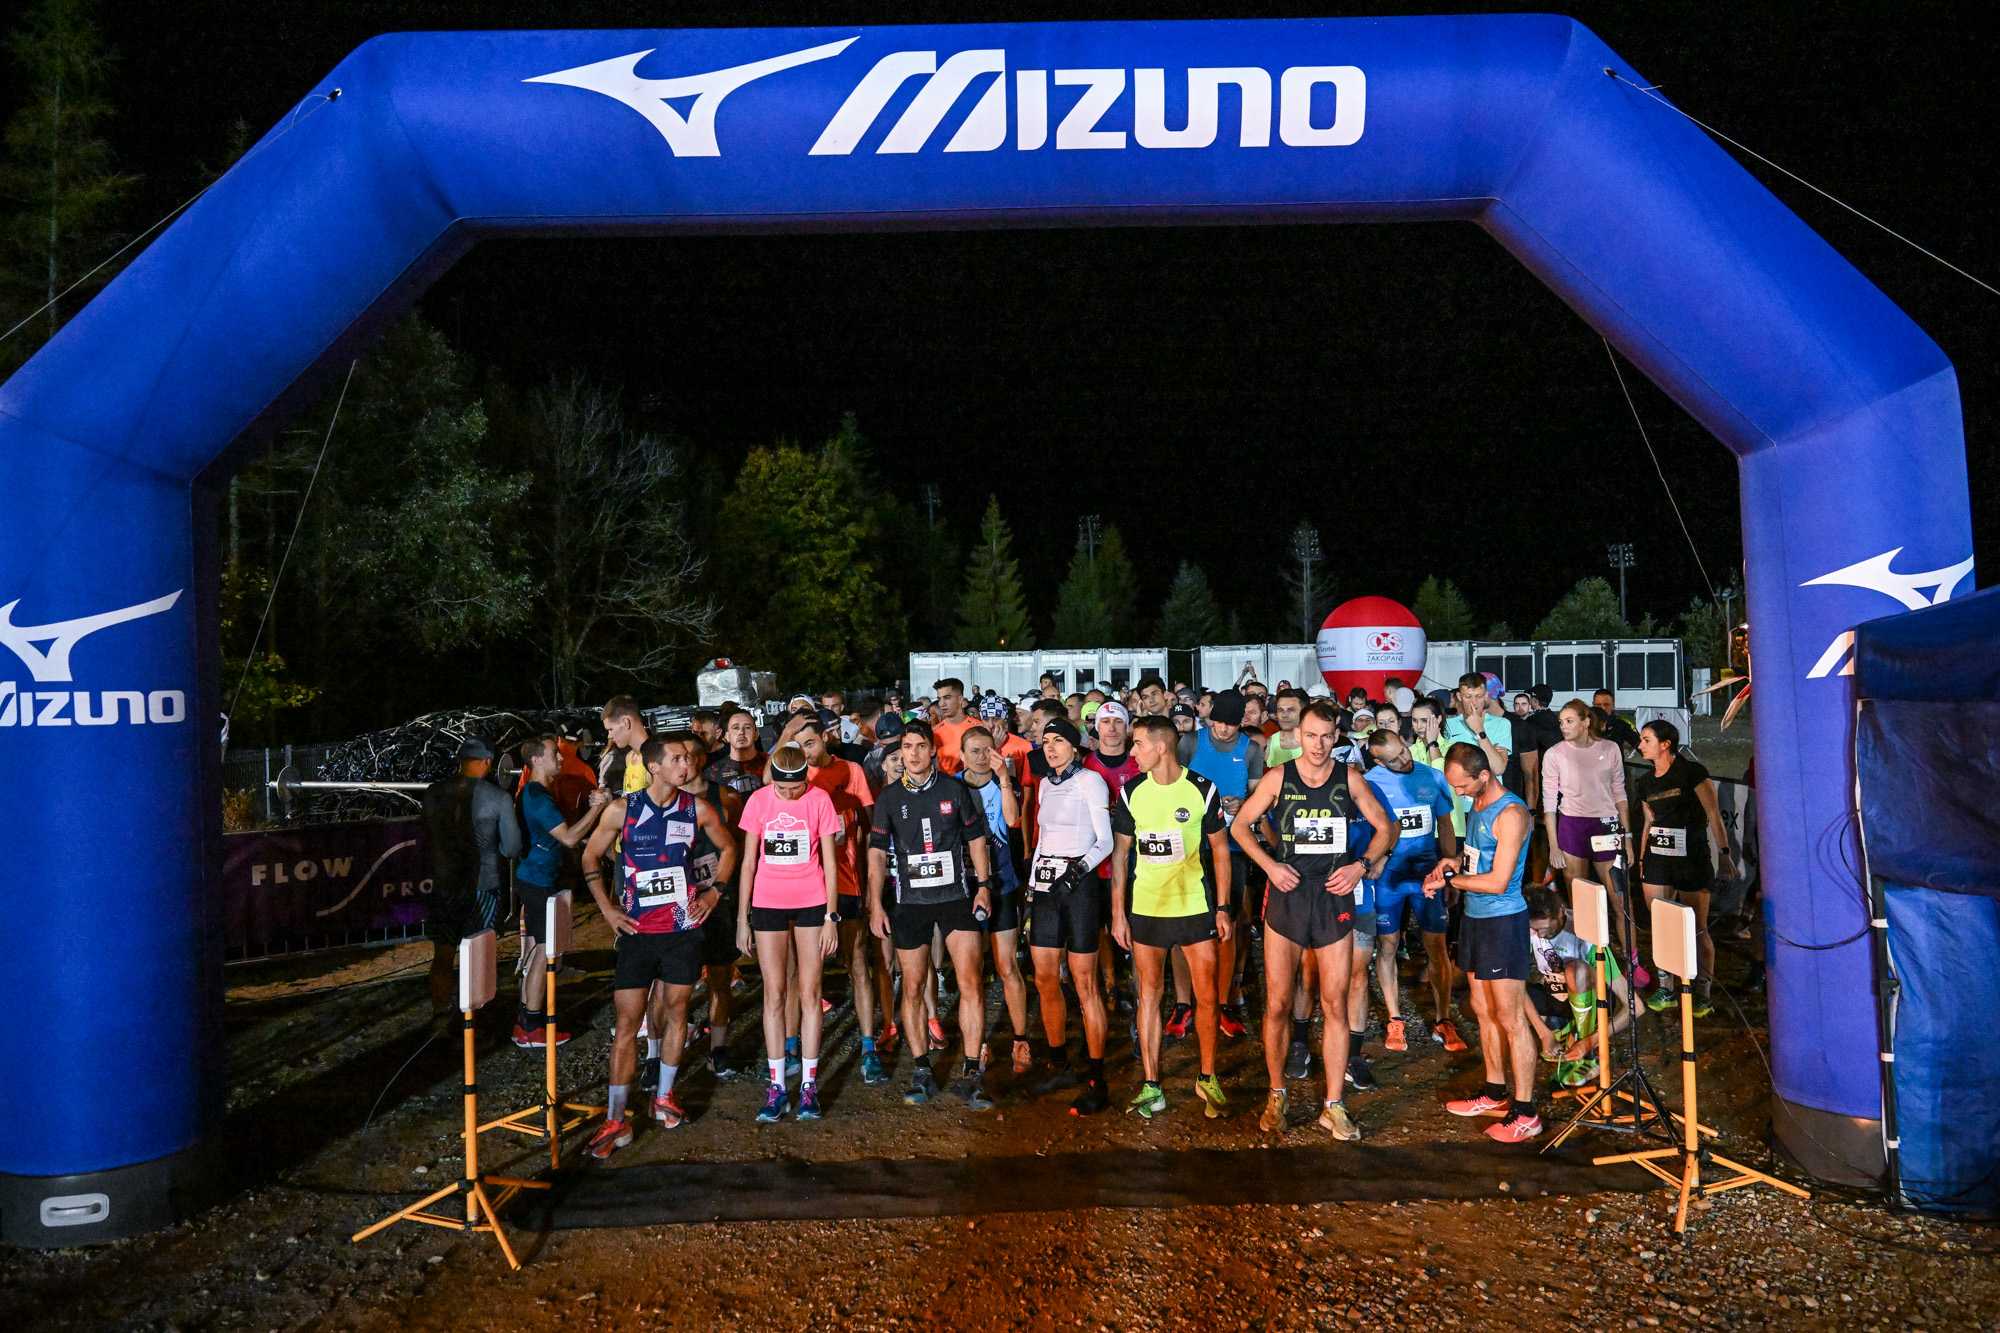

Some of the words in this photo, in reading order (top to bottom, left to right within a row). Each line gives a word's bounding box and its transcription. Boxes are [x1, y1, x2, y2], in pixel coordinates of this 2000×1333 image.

[807, 49, 1367, 155] MIZUNO
[0, 681, 186, 727] IZUNO
[1401, 817, 1416, 828] 91
[1308, 830, 1327, 841] 25
[1656, 836, 1670, 846] 23
[774, 842, 792, 853] 26
[1148, 842, 1165, 853] 90
[252, 856, 354, 886] FLOW
[920, 864, 937, 876] 86
[1040, 869, 1051, 880] 89
[646, 879, 672, 894] 115
